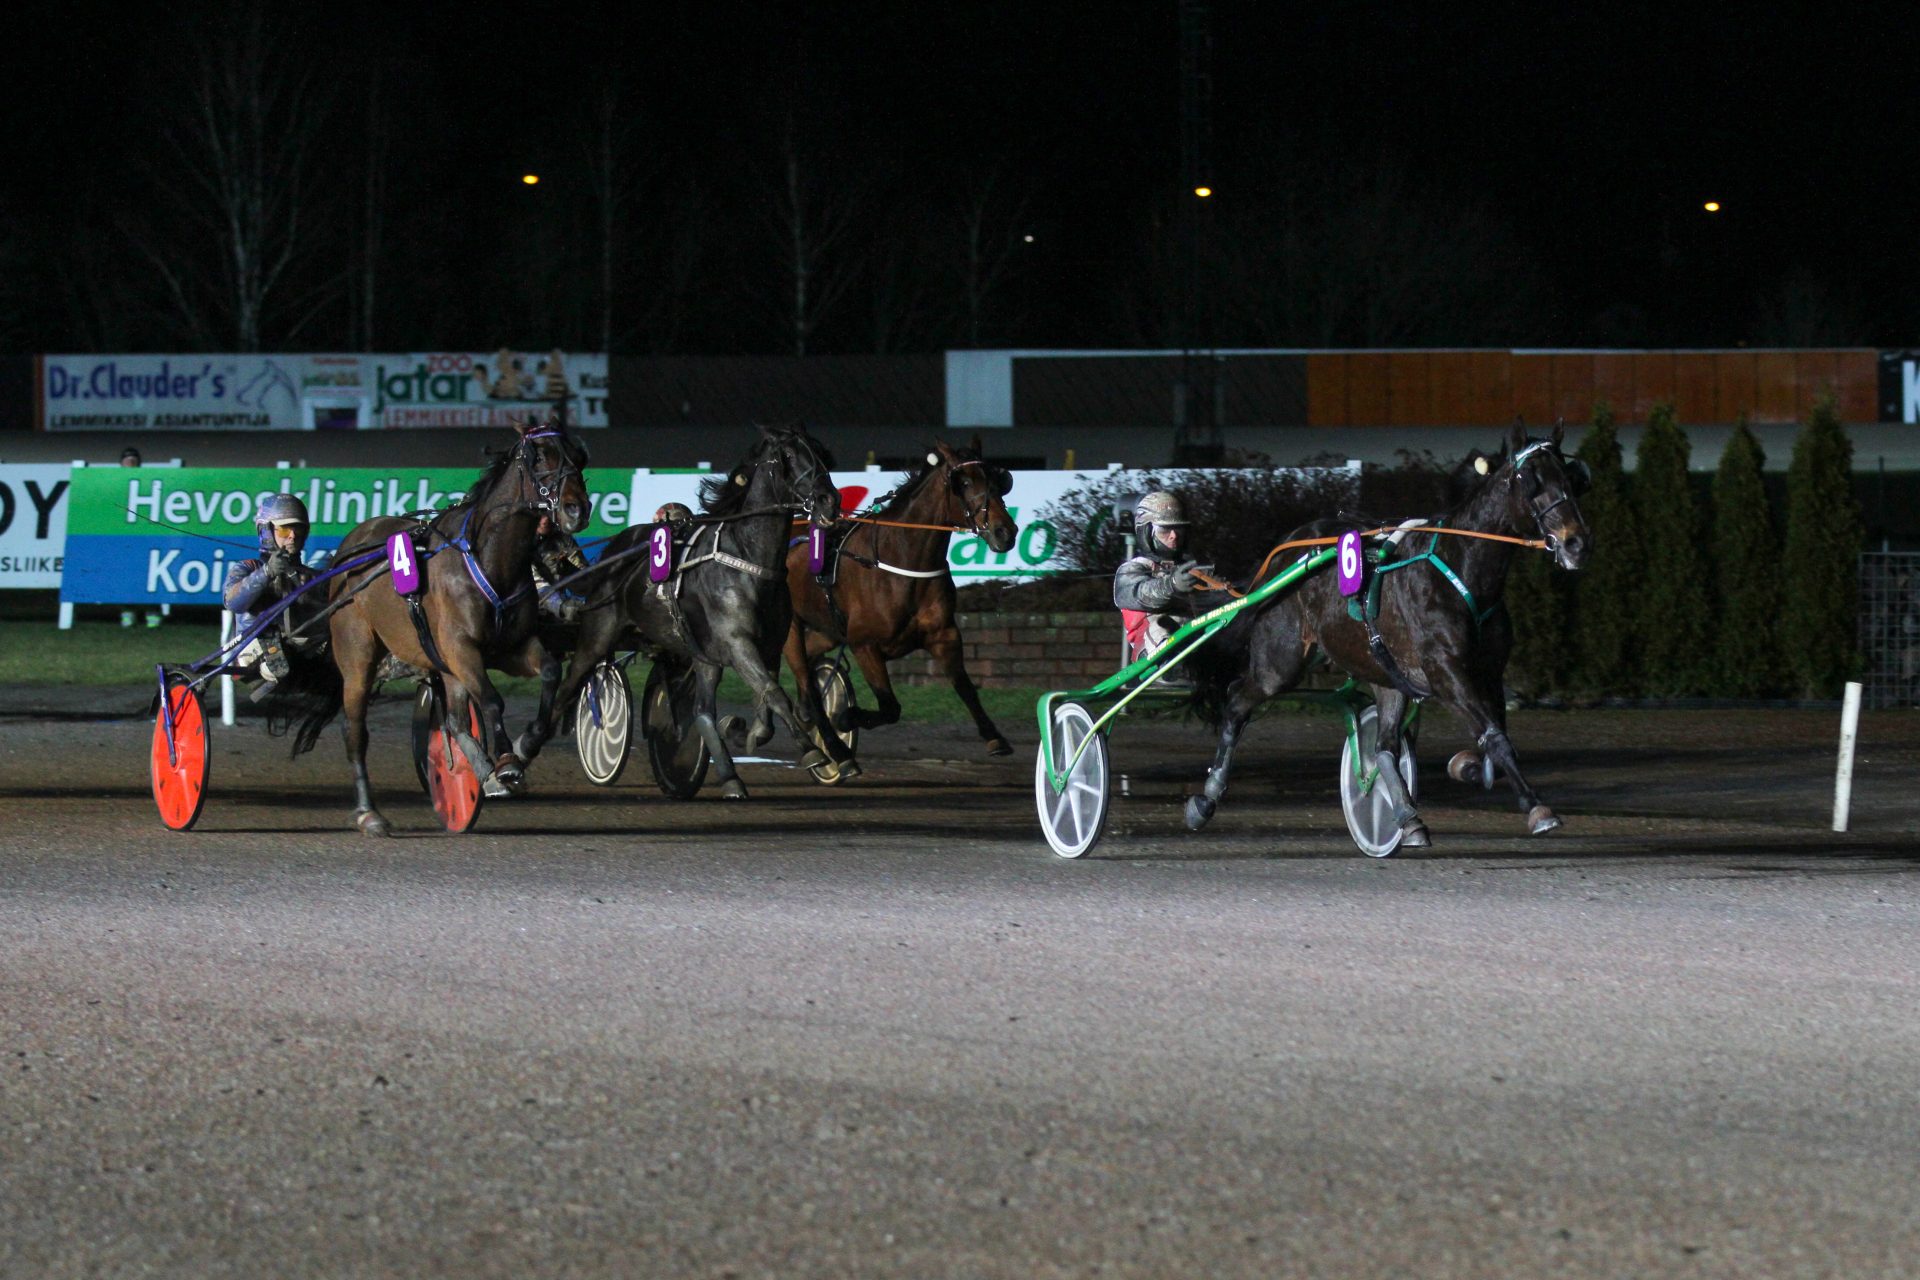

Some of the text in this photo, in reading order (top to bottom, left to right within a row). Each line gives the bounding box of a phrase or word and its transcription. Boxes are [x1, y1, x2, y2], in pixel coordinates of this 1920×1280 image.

[429, 354, 473, 372] ZOO
[126, 477, 467, 524] Hevolinikk
[393, 534, 411, 576] 4
[654, 528, 667, 567] 3
[814, 529, 819, 559] 1
[1342, 533, 1356, 578] 6
